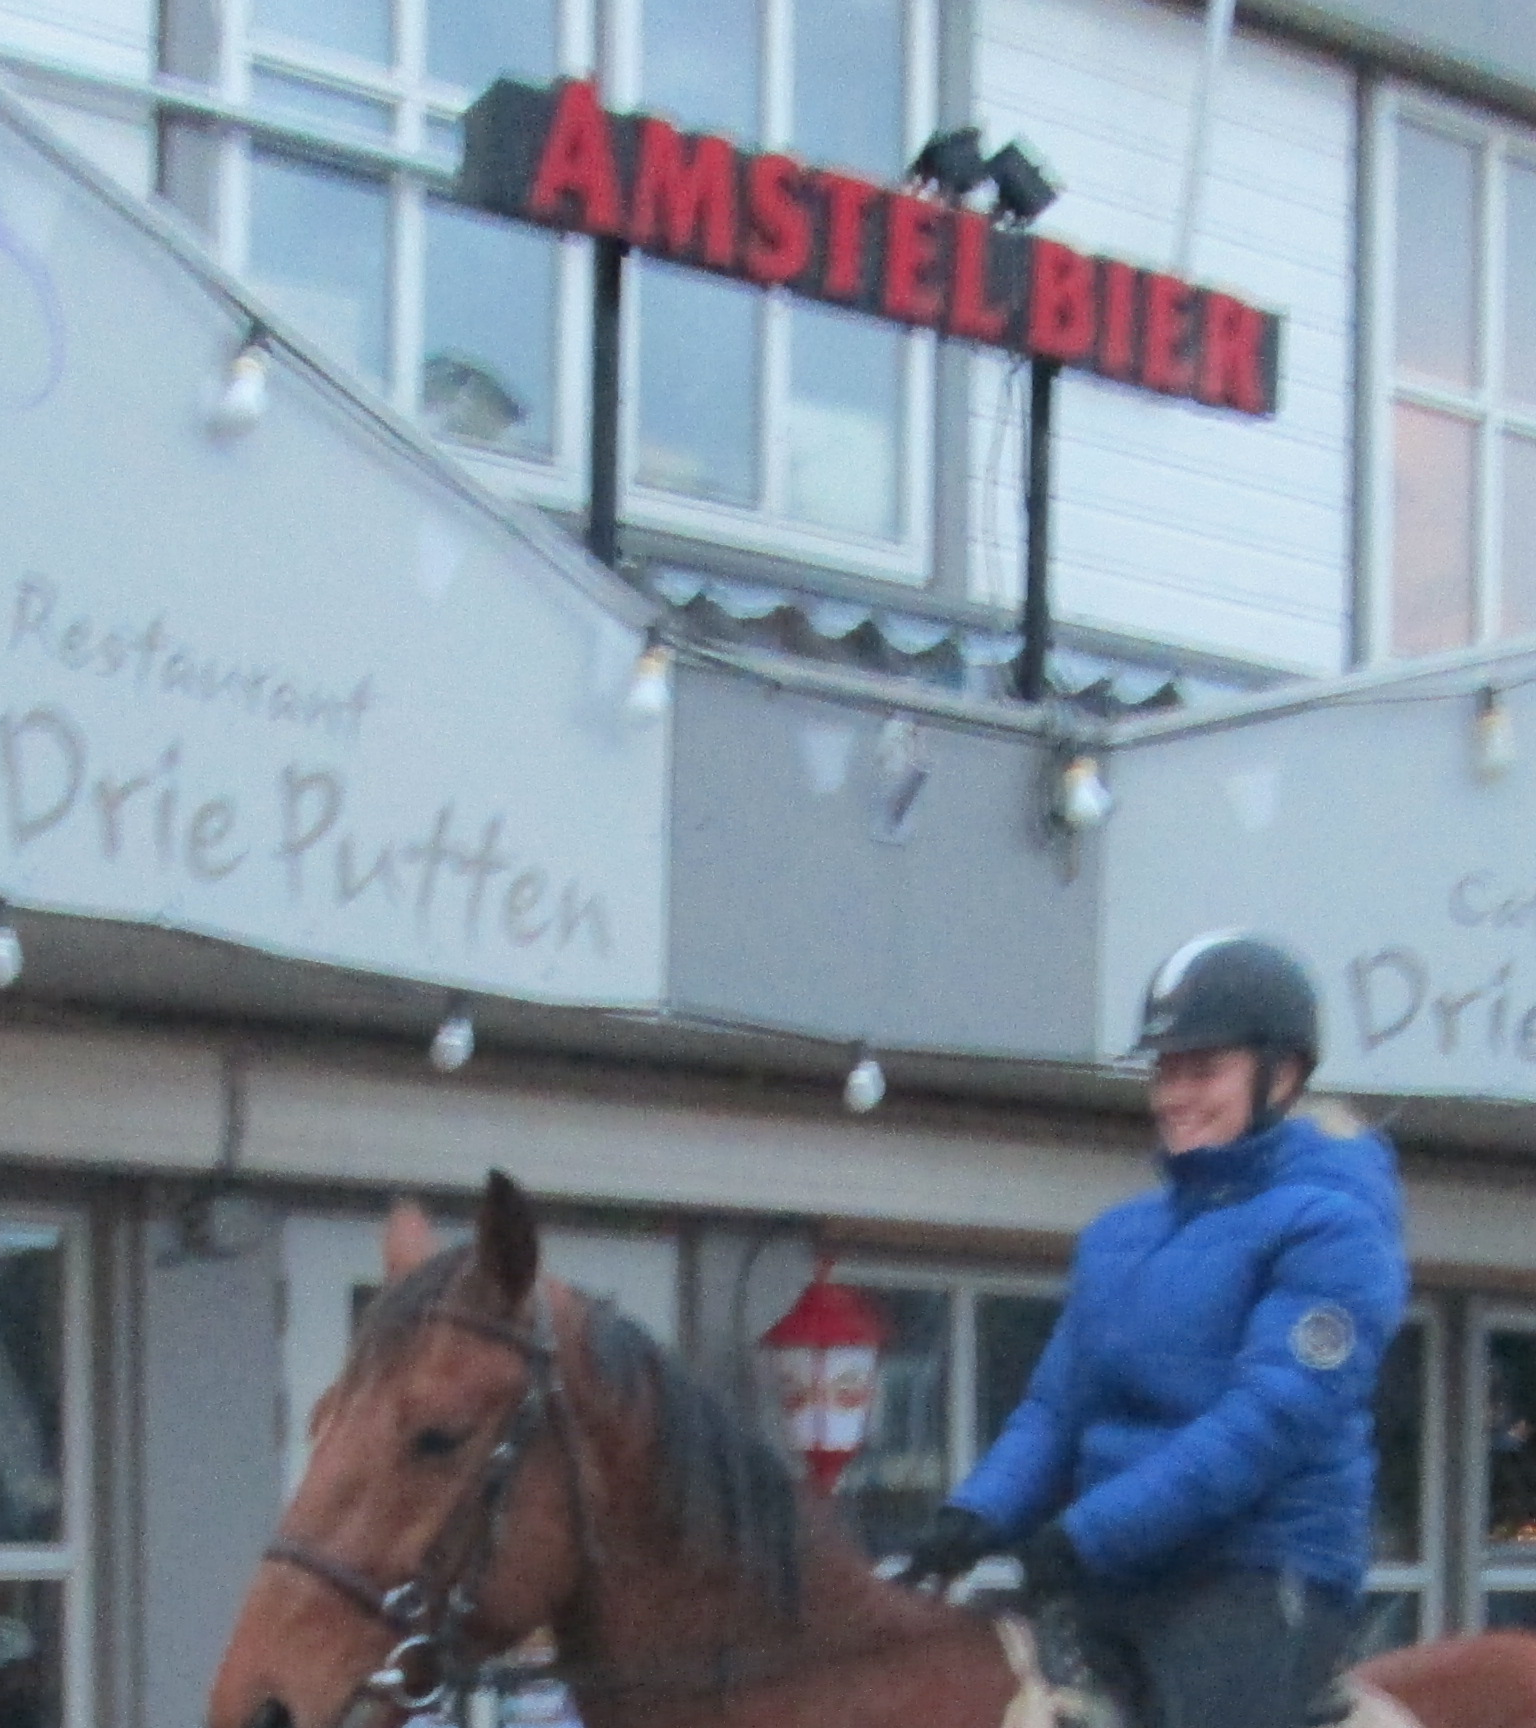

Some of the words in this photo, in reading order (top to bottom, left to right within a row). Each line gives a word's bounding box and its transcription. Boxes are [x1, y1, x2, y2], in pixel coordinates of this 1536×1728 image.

[532, 77, 1010, 337] AMSTEL
[1026, 236, 1265, 415] BIER
[7, 572, 379, 738] Restaurant
[272, 762, 616, 956] Putten
